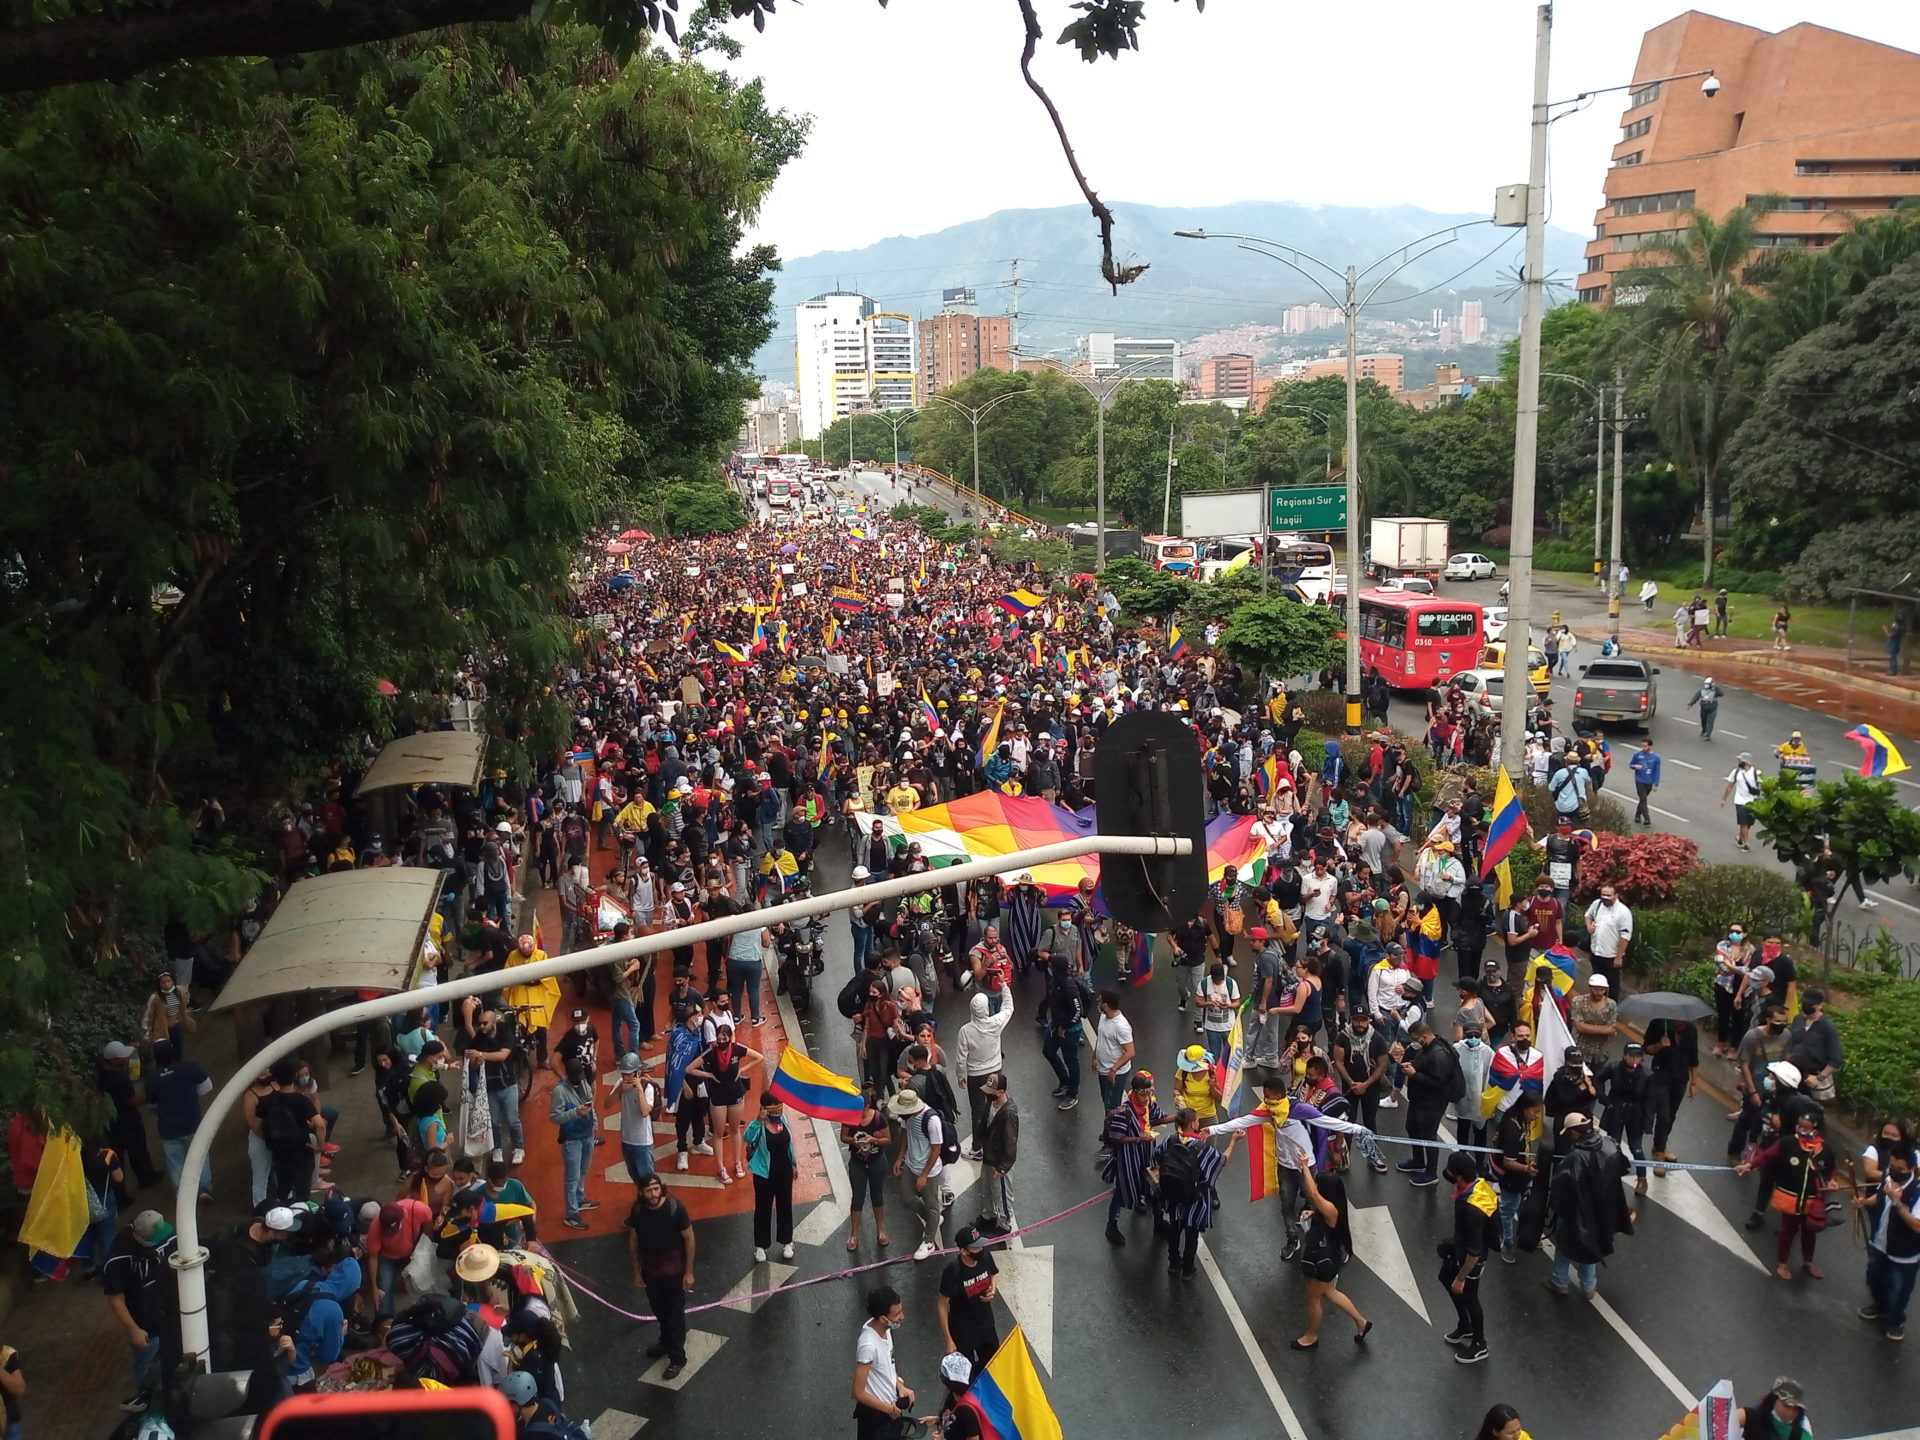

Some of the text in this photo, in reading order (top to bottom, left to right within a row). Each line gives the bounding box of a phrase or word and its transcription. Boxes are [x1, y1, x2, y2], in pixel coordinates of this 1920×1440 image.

[1276, 495, 1333, 508] Regional Sur
[1414, 638, 1432, 646] 0310
